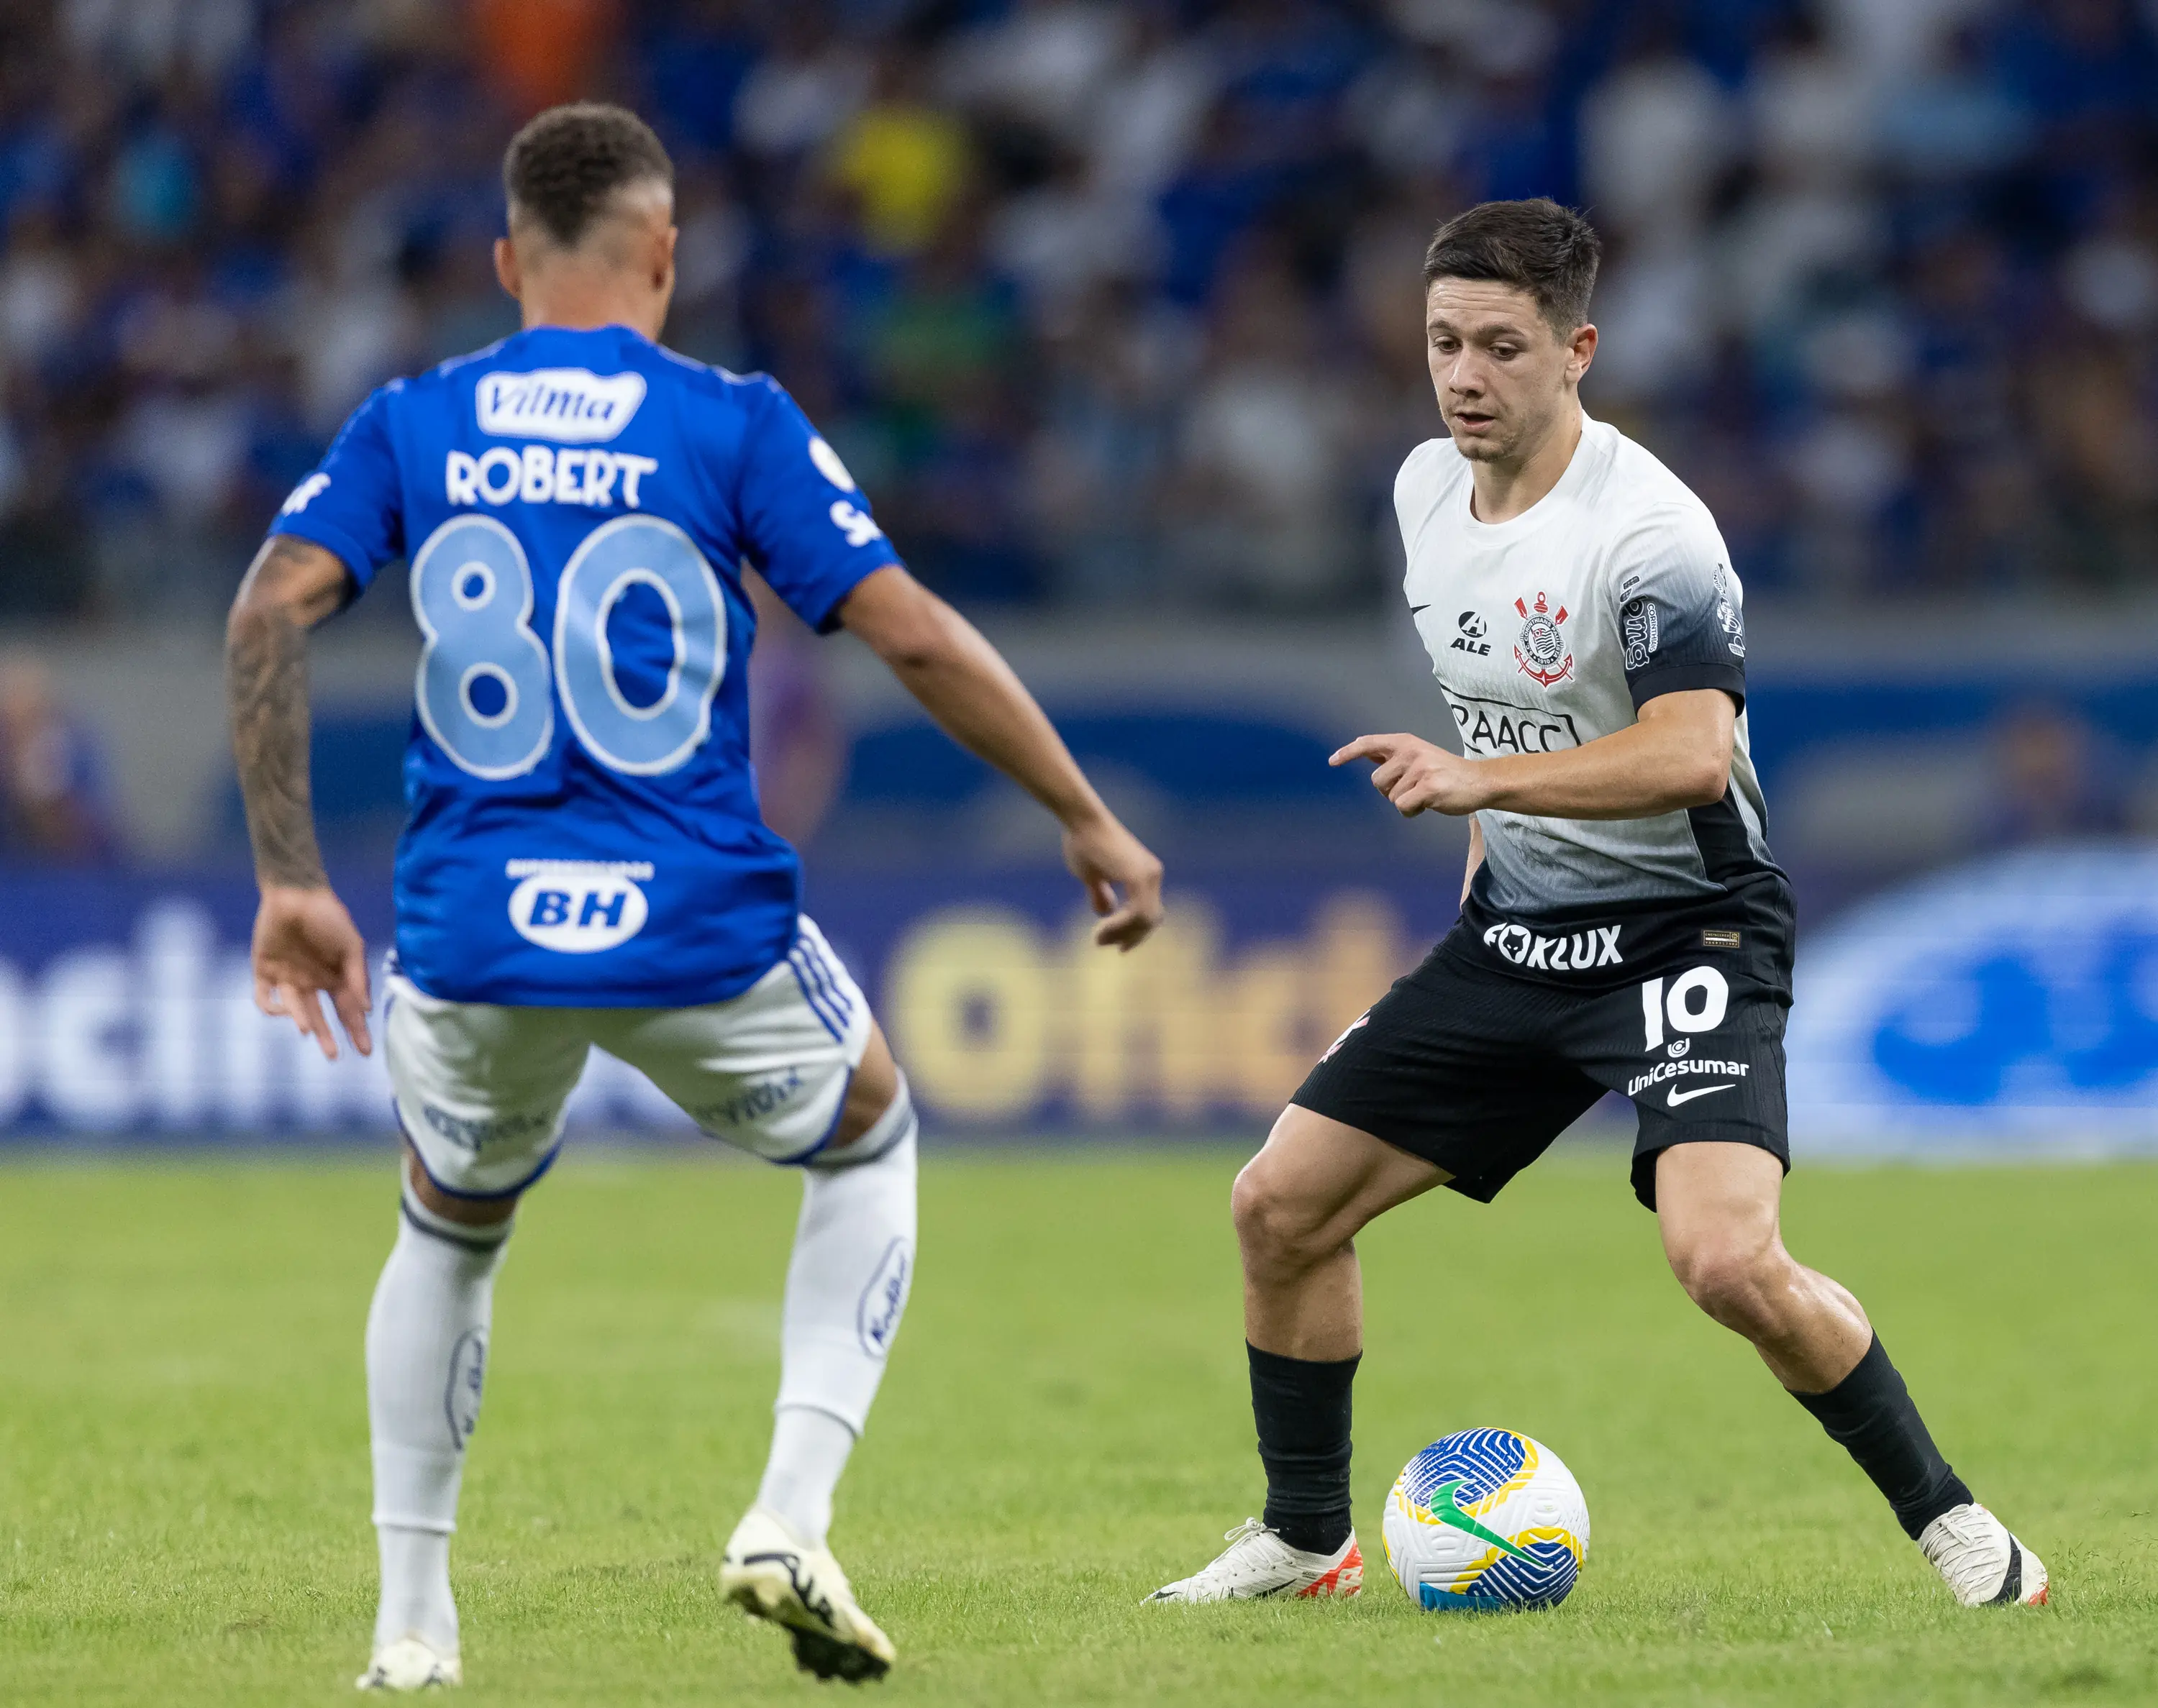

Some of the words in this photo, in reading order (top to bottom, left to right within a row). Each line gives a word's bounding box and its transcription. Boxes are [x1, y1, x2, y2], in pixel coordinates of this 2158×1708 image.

[491, 383, 616, 421] Vilma
[445, 444, 659, 509] ROBERT
[411, 513, 727, 781] 80
[1449, 637, 1492, 657] ALE
[1524, 616, 1552, 642] CORINTHIANS
[528, 889, 628, 928] BH
[1642, 965, 1729, 1053] 10
[1628, 1059, 1749, 1097] UniCesumar
